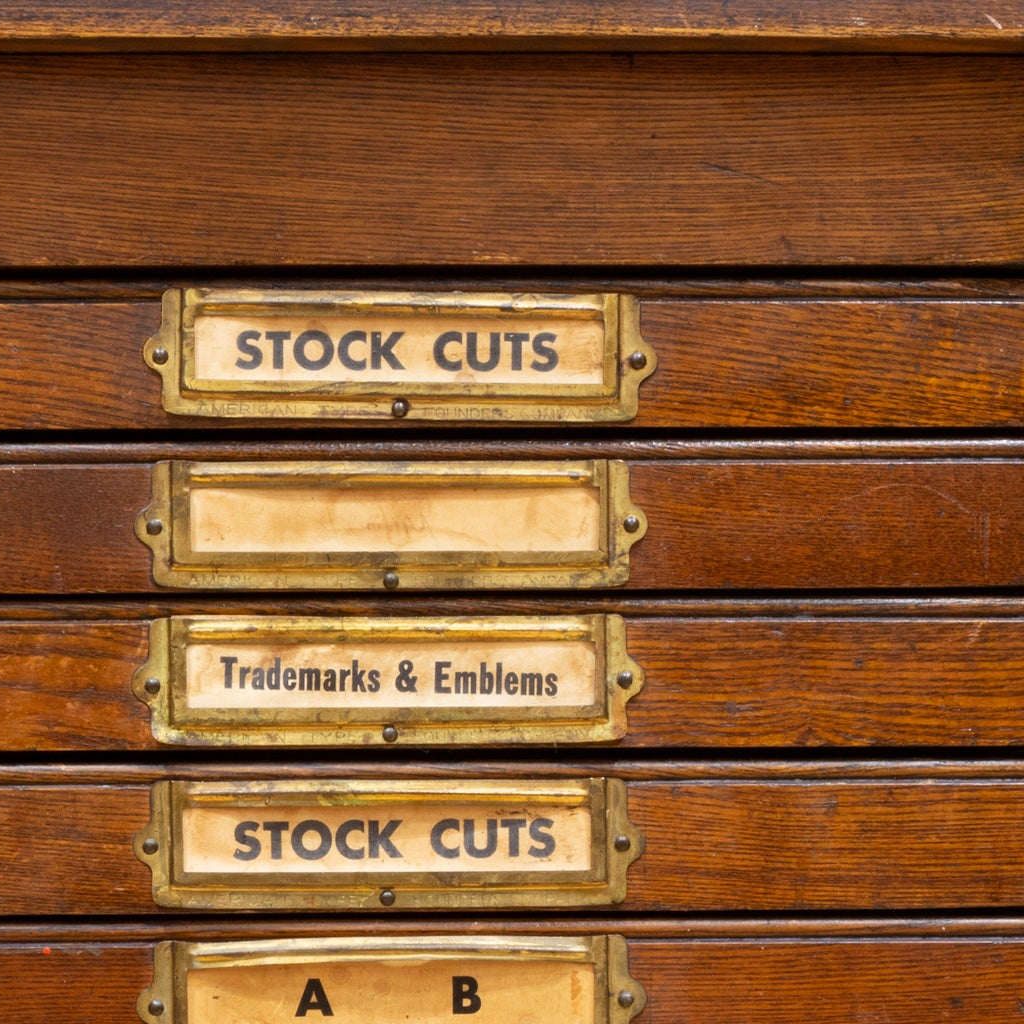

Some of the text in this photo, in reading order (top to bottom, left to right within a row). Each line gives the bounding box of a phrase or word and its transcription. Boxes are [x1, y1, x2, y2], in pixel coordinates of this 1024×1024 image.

[234, 330, 560, 372] STOCK CUTS
[195, 402, 297, 418] AMERICAN
[422, 406, 515, 419] FOUNDERS
[220, 656, 558, 696] Trademarks & Emblems
[233, 818, 556, 862] STOCK CUTS
[294, 976, 482, 1018] A B
